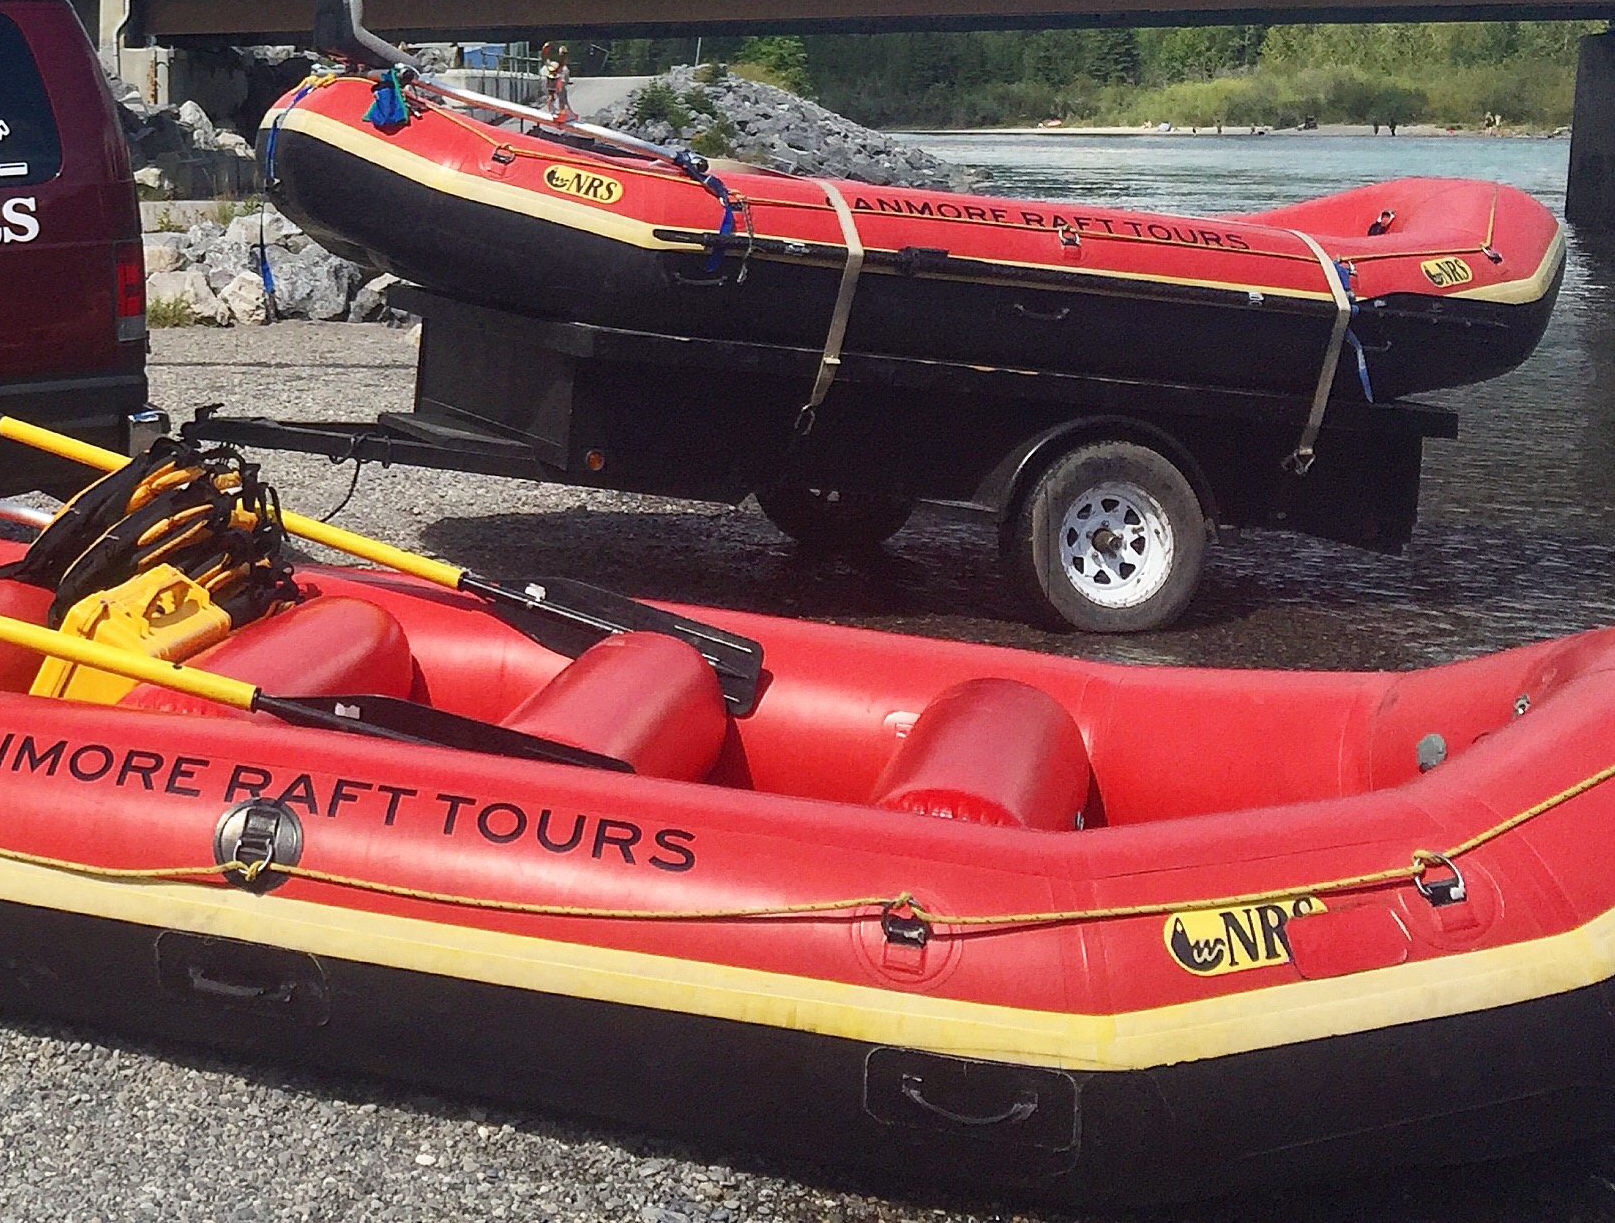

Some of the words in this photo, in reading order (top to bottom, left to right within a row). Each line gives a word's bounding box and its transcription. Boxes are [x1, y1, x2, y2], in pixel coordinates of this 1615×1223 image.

[566, 173, 618, 201] NRS
[1020, 211, 1116, 235] RAFT
[1124, 220, 1251, 251] TOURS
[1435, 258, 1470, 285] NRS
[223, 764, 419, 826] RAFT
[435, 792, 698, 874] TOURS
